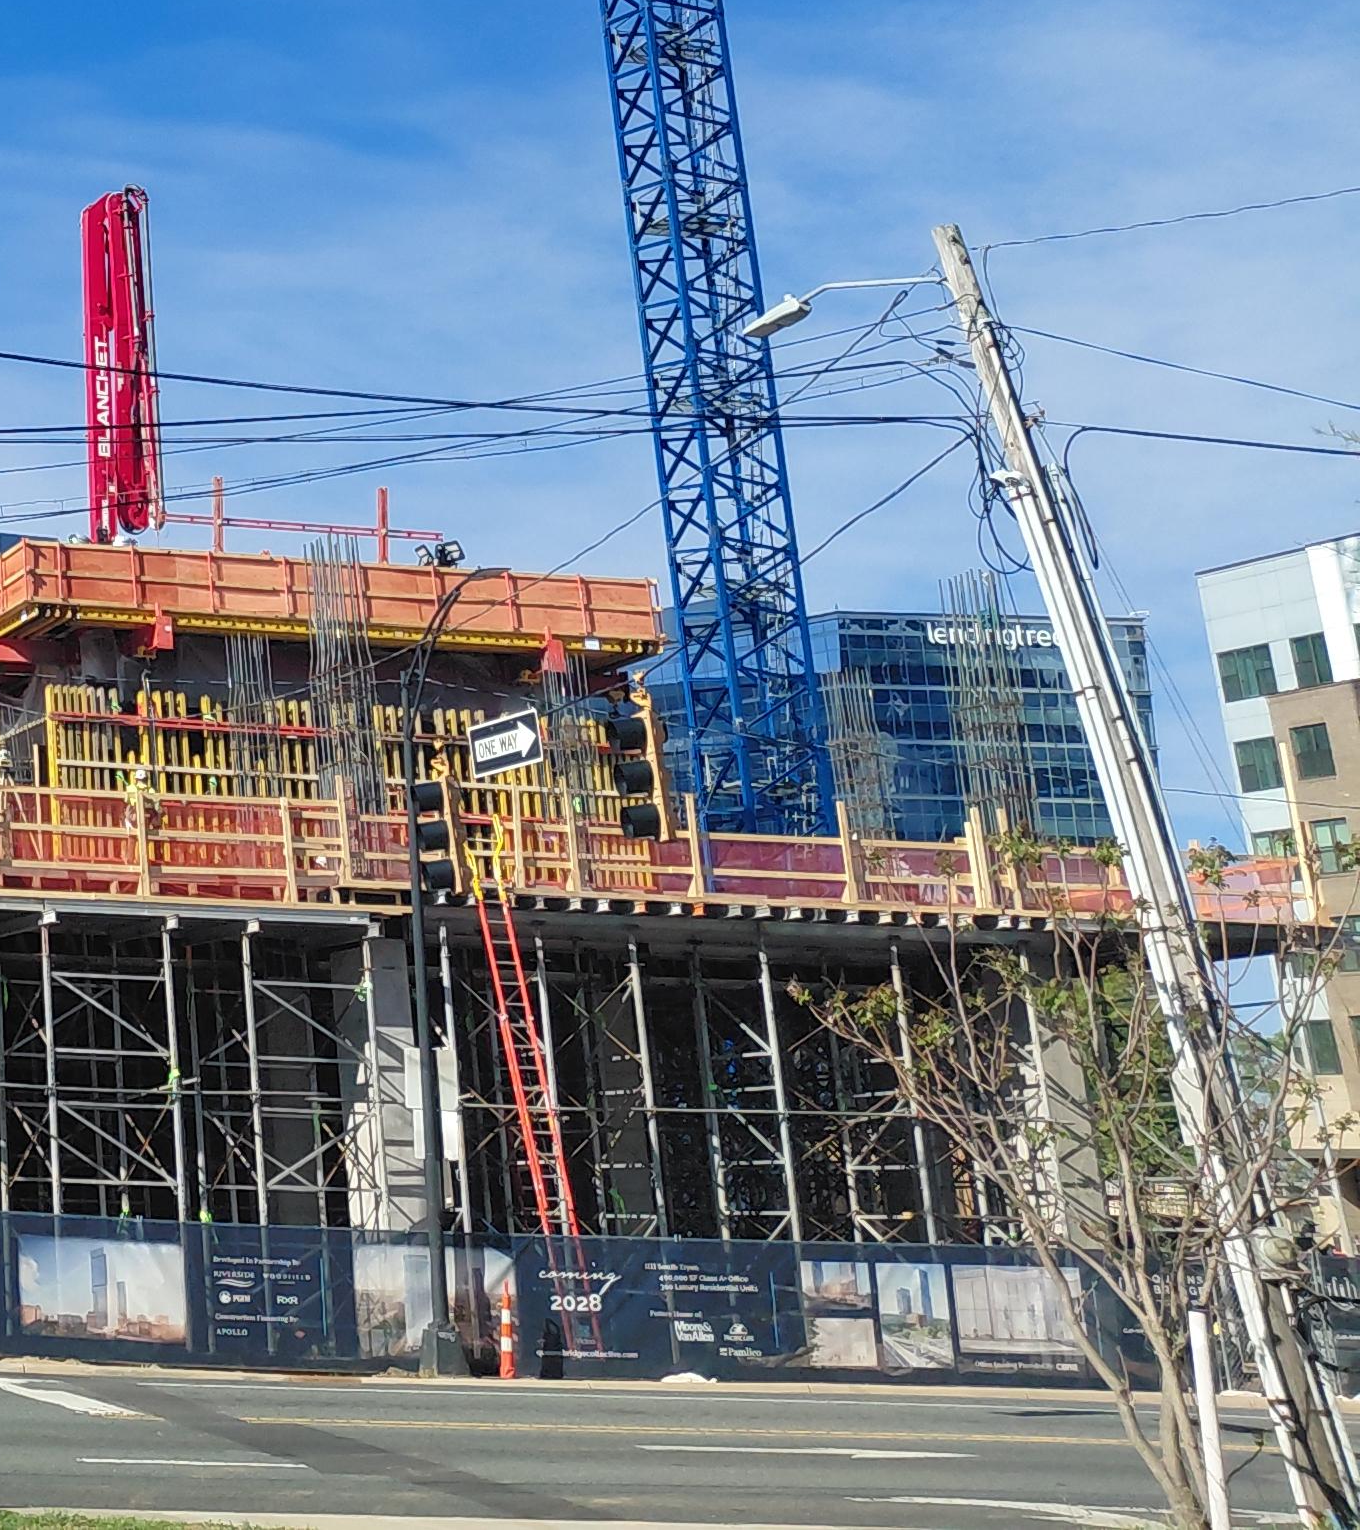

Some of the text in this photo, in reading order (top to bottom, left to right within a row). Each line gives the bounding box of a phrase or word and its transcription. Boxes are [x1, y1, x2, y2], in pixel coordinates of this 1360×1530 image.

[95, 336, 111, 457] BLANCHET
[479, 733, 518, 759] ONE WAY
[213, 1270, 256, 1279] RIVERSIDE
[539, 1261, 622, 1296] coming
[1152, 1274, 1204, 1285] QNS
[1153, 1284, 1203, 1296] BRG
[276, 1295, 298, 1305] RXR
[549, 1293, 602, 1312] 2028
[216, 1328, 248, 1336] APOLLO
[728, 1347, 763, 1358] Pamlico
